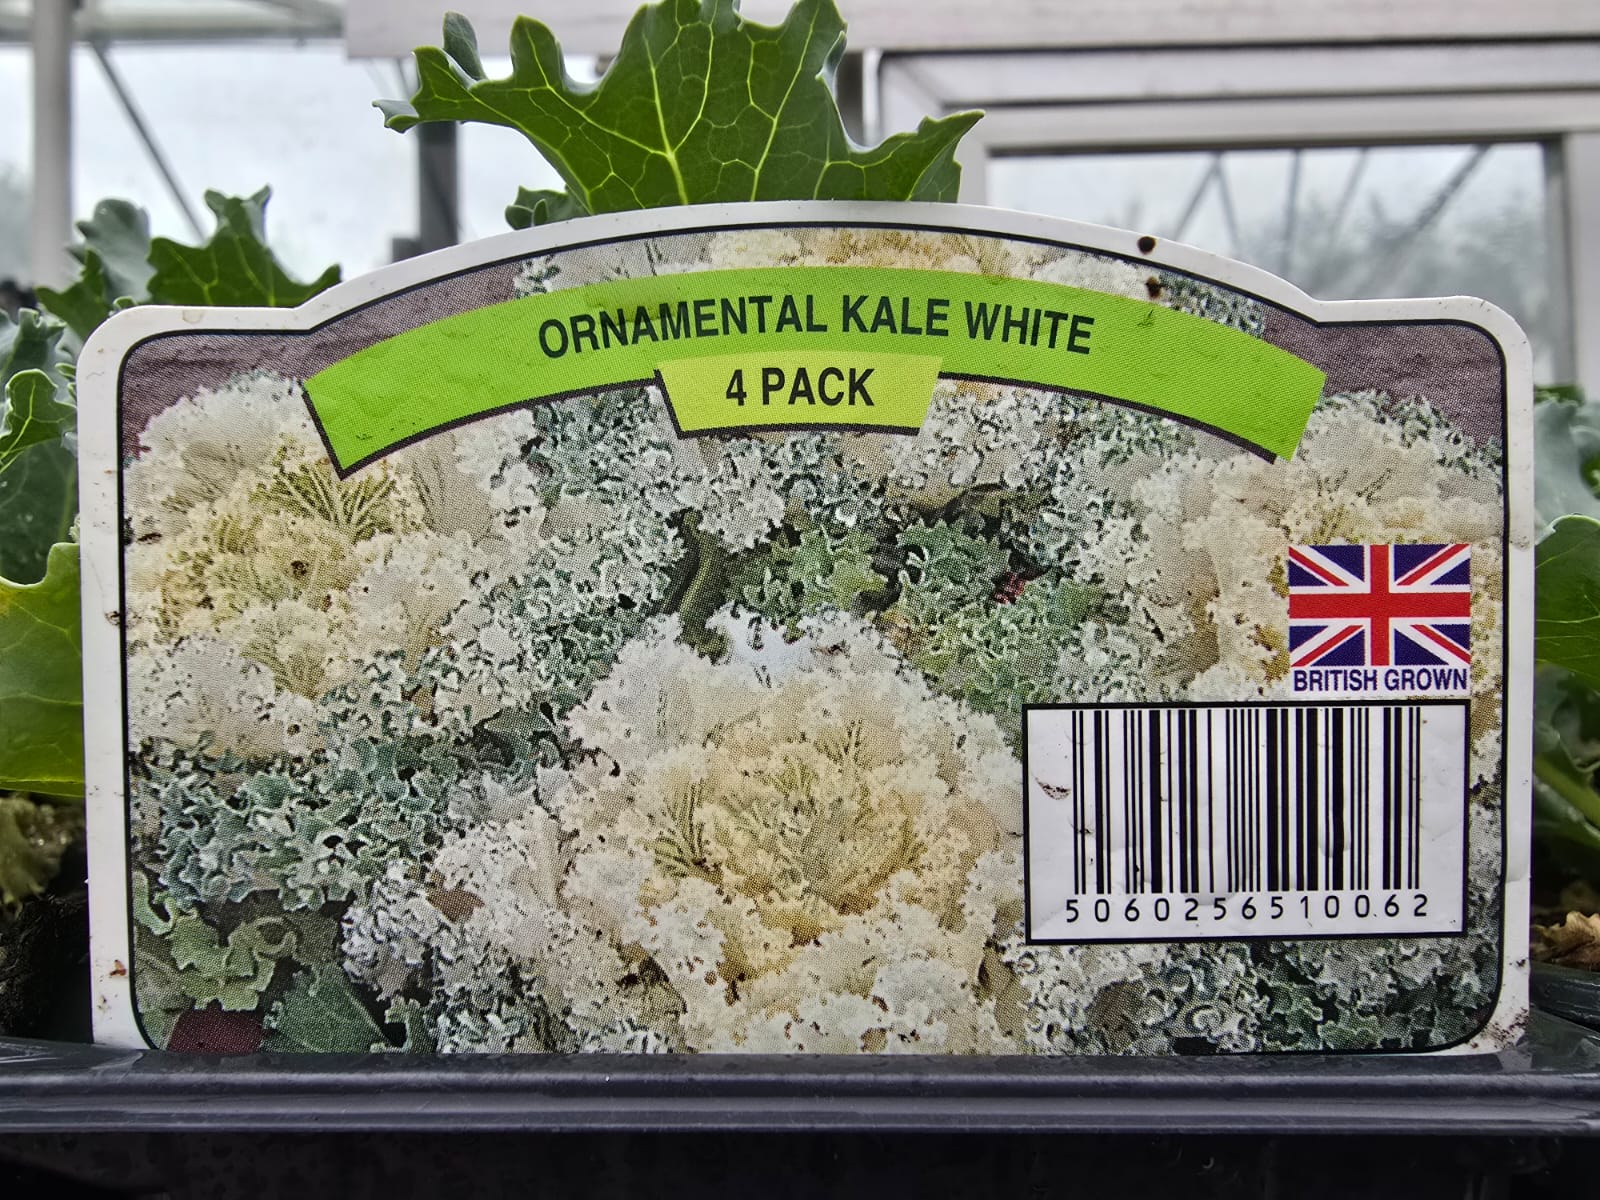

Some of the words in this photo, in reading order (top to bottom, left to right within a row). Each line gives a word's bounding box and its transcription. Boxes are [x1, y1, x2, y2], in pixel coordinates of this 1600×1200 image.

[538, 295, 828, 358] ORNAMENTAL
[842, 296, 949, 337] KALE
[965, 301, 1096, 355] WHITE
[725, 369, 747, 406] 4
[761, 367, 875, 406] PACK
[1293, 669, 1378, 691] BRITISH
[1384, 668, 1468, 691] GROWN
[1065, 894, 1429, 923] 5060256510062
